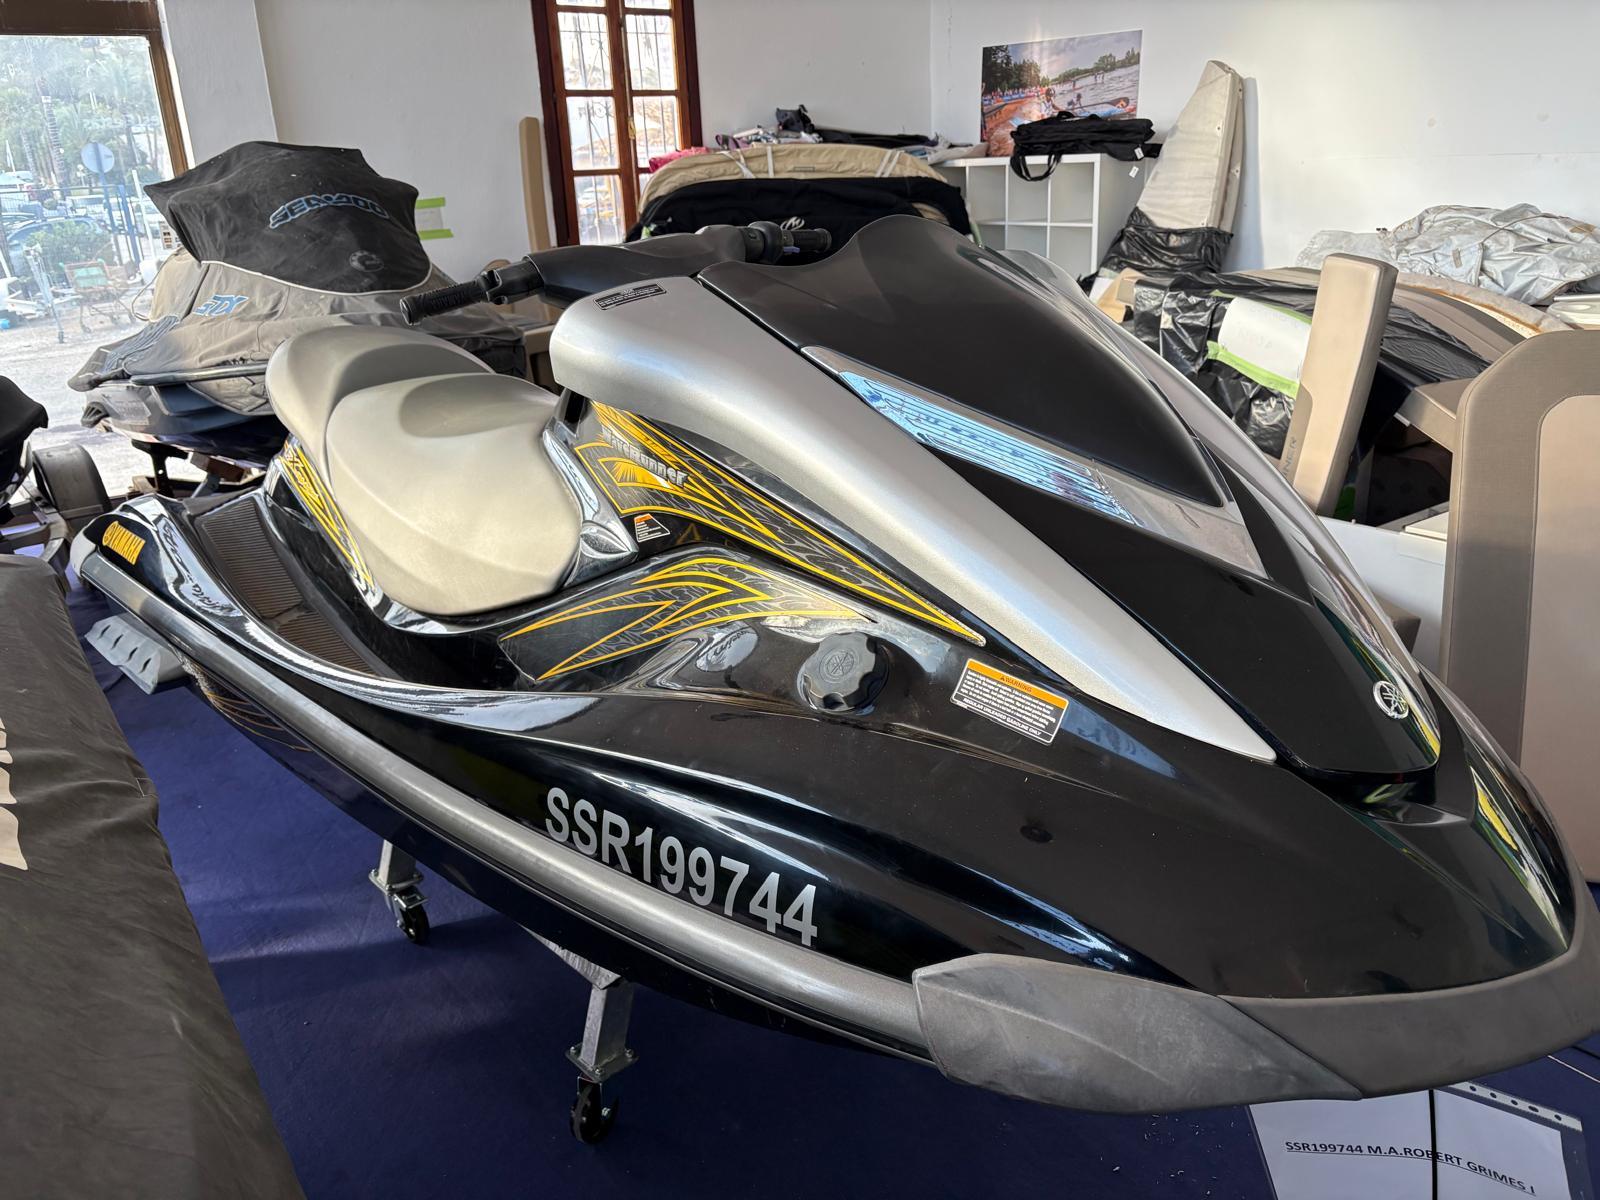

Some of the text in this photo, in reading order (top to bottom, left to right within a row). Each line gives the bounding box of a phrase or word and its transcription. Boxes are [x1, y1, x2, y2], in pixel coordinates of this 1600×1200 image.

[107, 523, 146, 565] YAMAHA
[1005, 677, 1032, 692] WARNING
[963, 698, 984, 710] REGULAR
[983, 707, 1007, 720] UNLEADED
[1006, 717, 1029, 730] GASOLINE
[1029, 727, 1042, 736] ONLY
[545, 787, 818, 947] SSR199744
[1285, 1141, 1363, 1154] SSR199744
[1368, 1145, 1463, 1166] M.A.ROBERT
[1467, 1161, 1526, 1190] GRIMES
